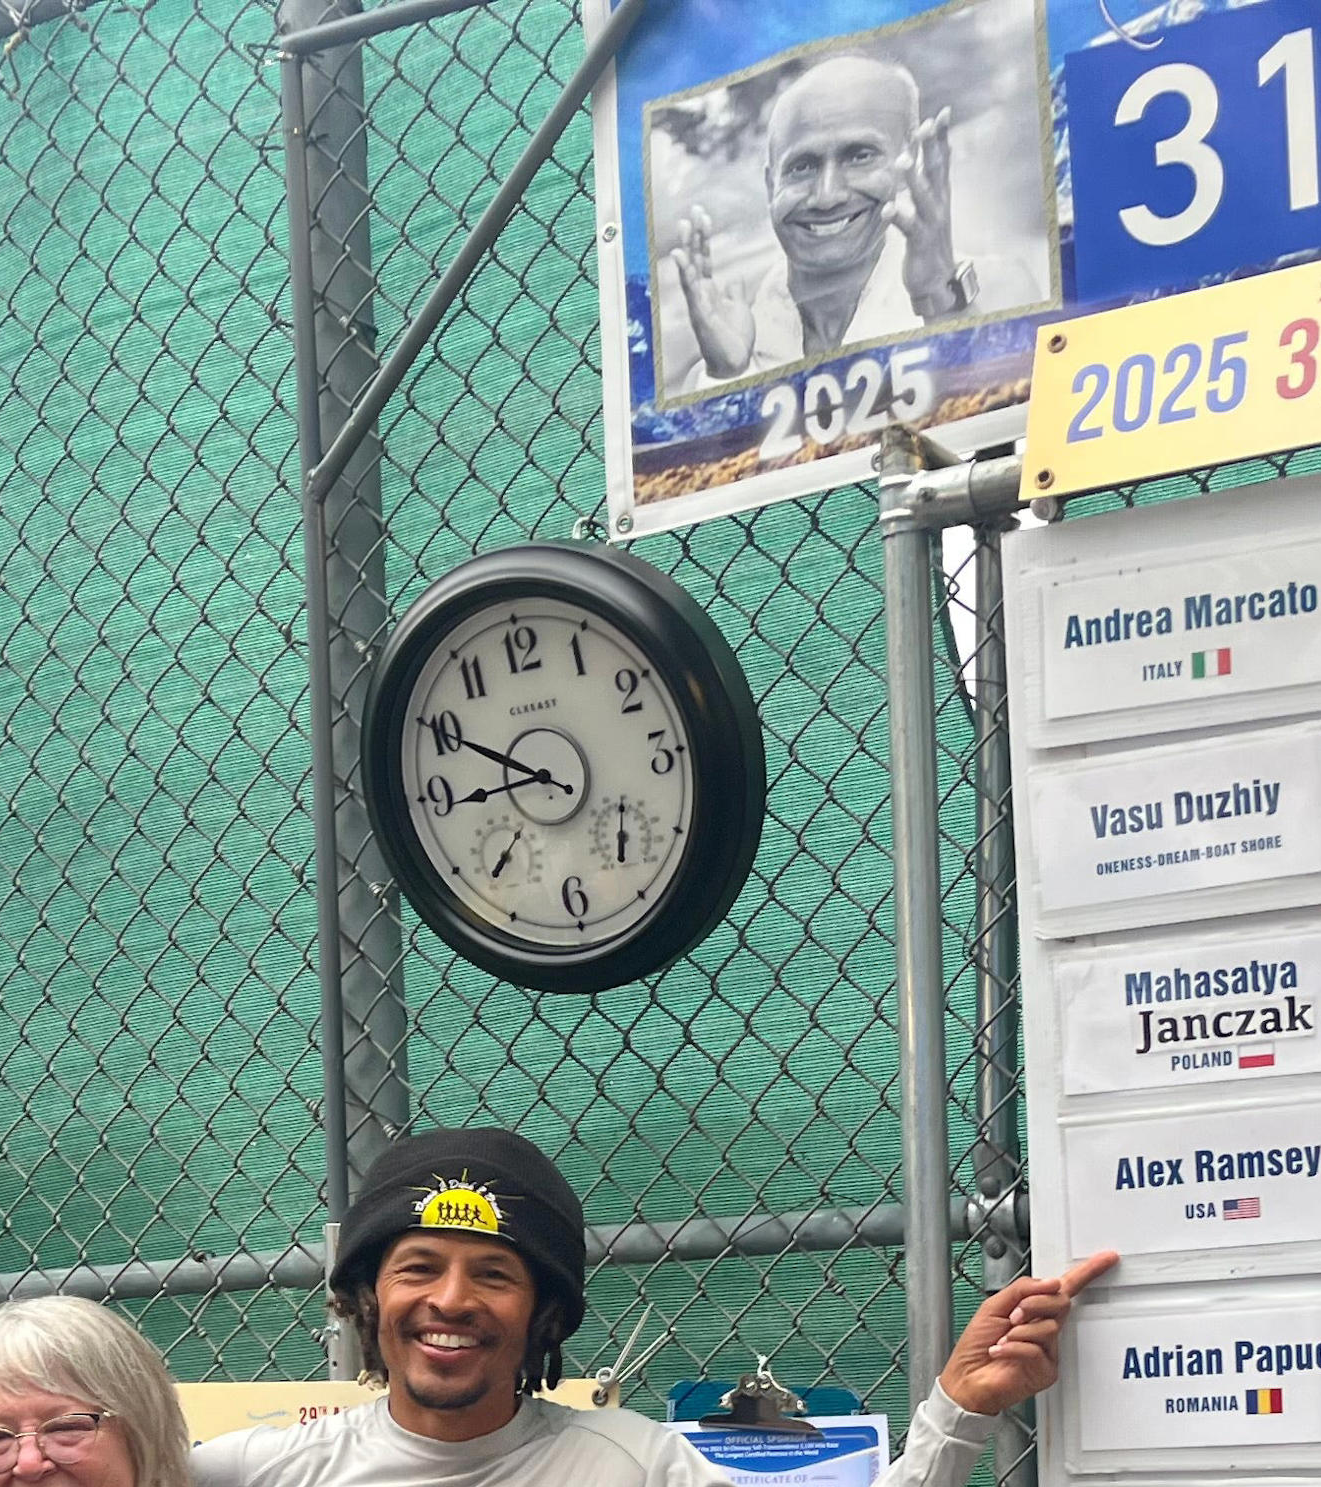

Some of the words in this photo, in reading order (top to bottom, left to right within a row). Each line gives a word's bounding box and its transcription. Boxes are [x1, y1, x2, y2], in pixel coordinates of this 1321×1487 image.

[758, 347, 933, 462] 2025
[1066, 331, 1250, 444] 2025
[1064, 603, 1172, 650] Andrea
[1184, 580, 1319, 631] Marcato
[504, 626, 542, 674] 12
[568, 632, 587, 676] 1
[1141, 660, 1183, 681] ITALY
[458, 656, 488, 700] 11
[614, 668, 644, 714] 2
[426, 710, 463, 755] 10
[647, 729, 675, 775] 3
[426, 775, 454, 817] 9
[1091, 798, 1163, 840] Vasu
[1174, 778, 1282, 829] Duzhiy
[1095, 839, 1237, 876] ONENESS-DREAM-BOAT
[1240, 835, 1282, 855] SHORE
[561, 875, 589, 917] 6
[1125, 957, 1298, 1006] Mahasatya
[1136, 996, 1314, 1054] Janczak
[1171, 1048, 1233, 1072] POLAND
[1115, 1151, 1183, 1191] Alex
[1196, 1143, 1321, 1184] Ramsey
[1184, 1201, 1216, 1220] USA
[1122, 1342, 1224, 1380] Adrian
[1165, 1394, 1239, 1415] ROMANIA
